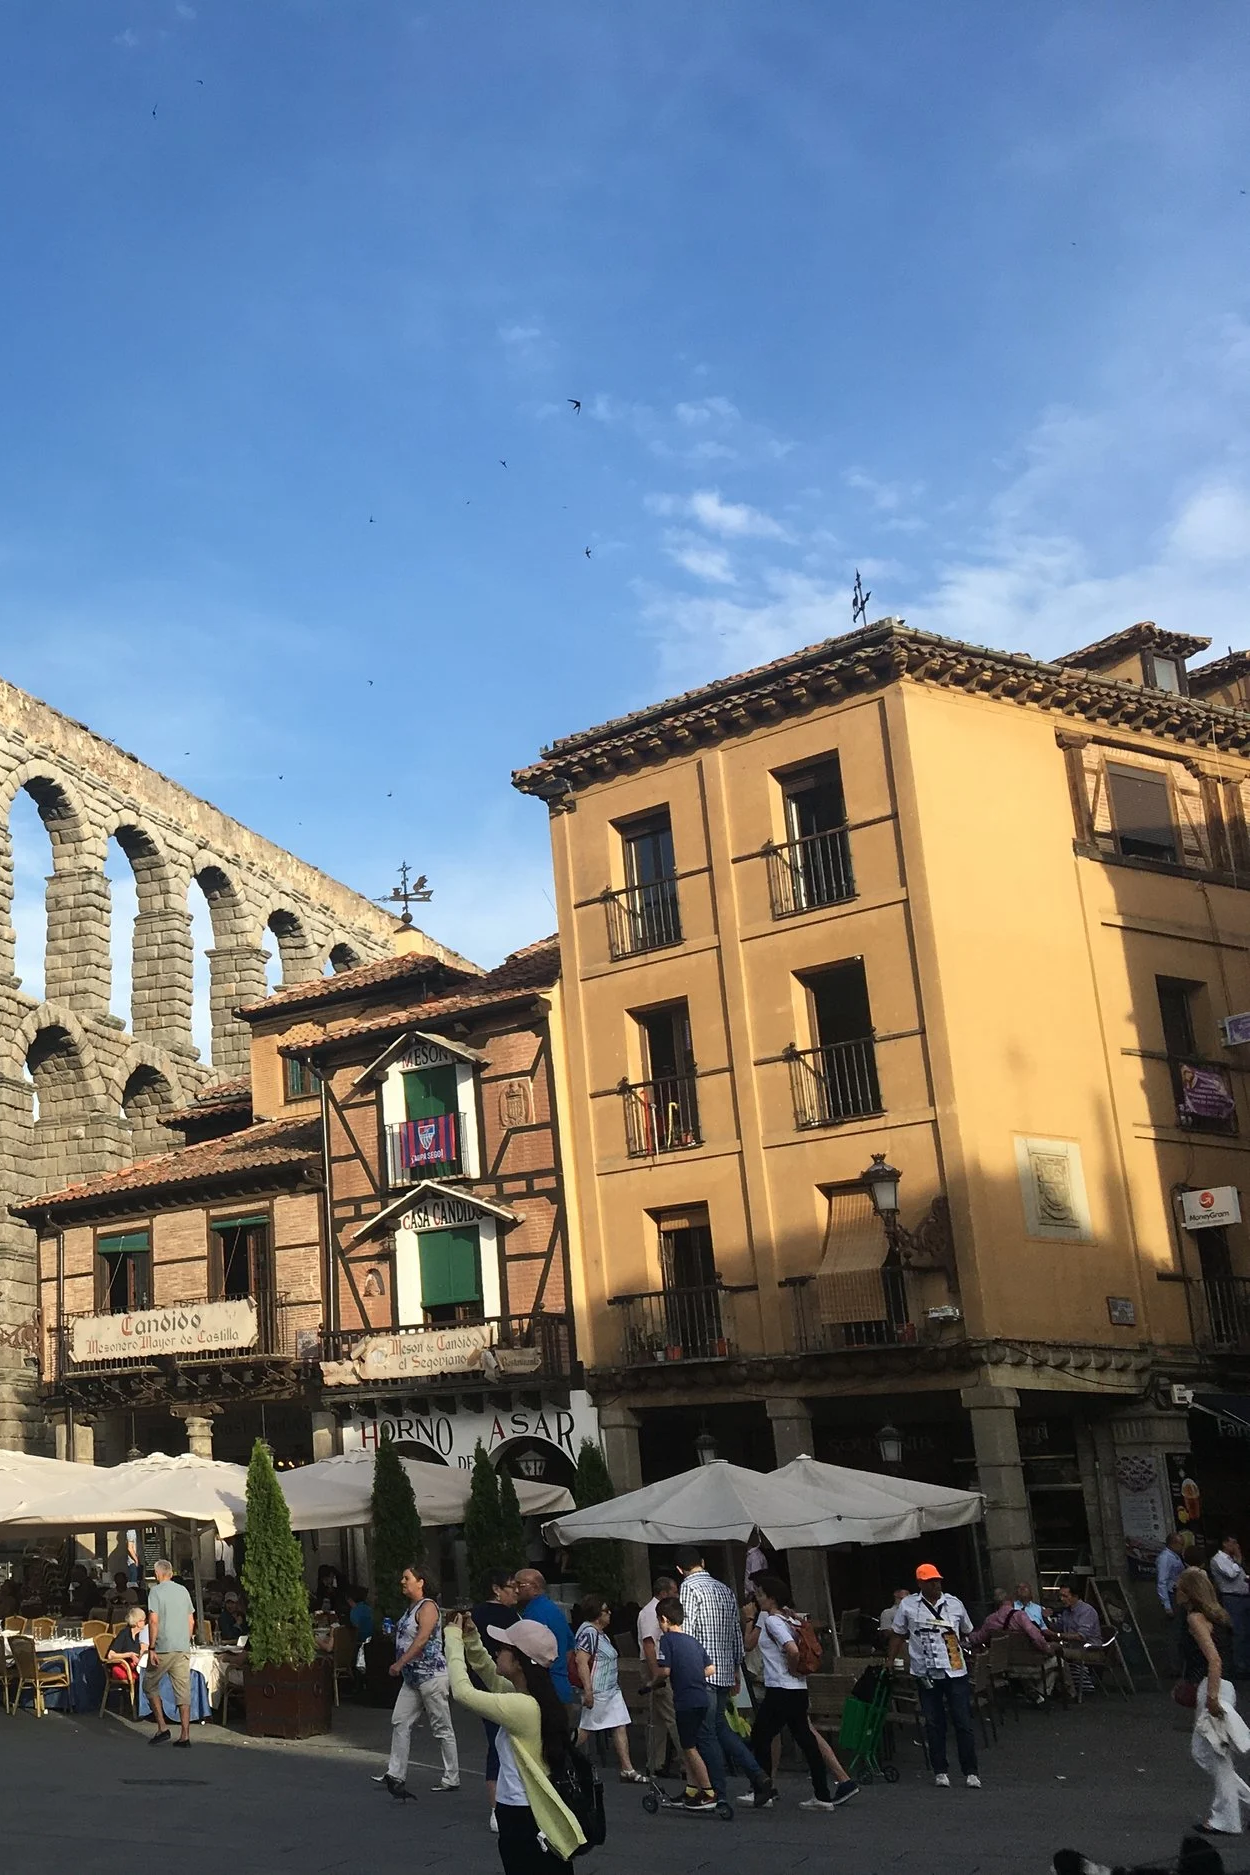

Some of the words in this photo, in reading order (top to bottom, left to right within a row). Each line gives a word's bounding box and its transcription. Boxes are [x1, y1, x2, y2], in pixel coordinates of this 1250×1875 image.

[402, 1046, 448, 1068] MESON
[402, 1206, 430, 1230] CASA
[432, 1200, 483, 1226] CANDIDO
[1190, 1210, 1230, 1221] MoneyGram
[121, 1313, 201, 1336] Candido
[86, 1337, 138, 1355] Mesonero
[139, 1335, 176, 1351] Mayor
[180, 1334, 193, 1345] de
[197, 1328, 239, 1344] Castilla
[388, 1339, 423, 1356] Meson
[436, 1335, 478, 1351] Candido
[398, 1358, 407, 1370] el
[411, 1355, 467, 1373] Segoviano
[361, 1416, 453, 1456] HORNO
[488, 1411, 578, 1466] ASAR
